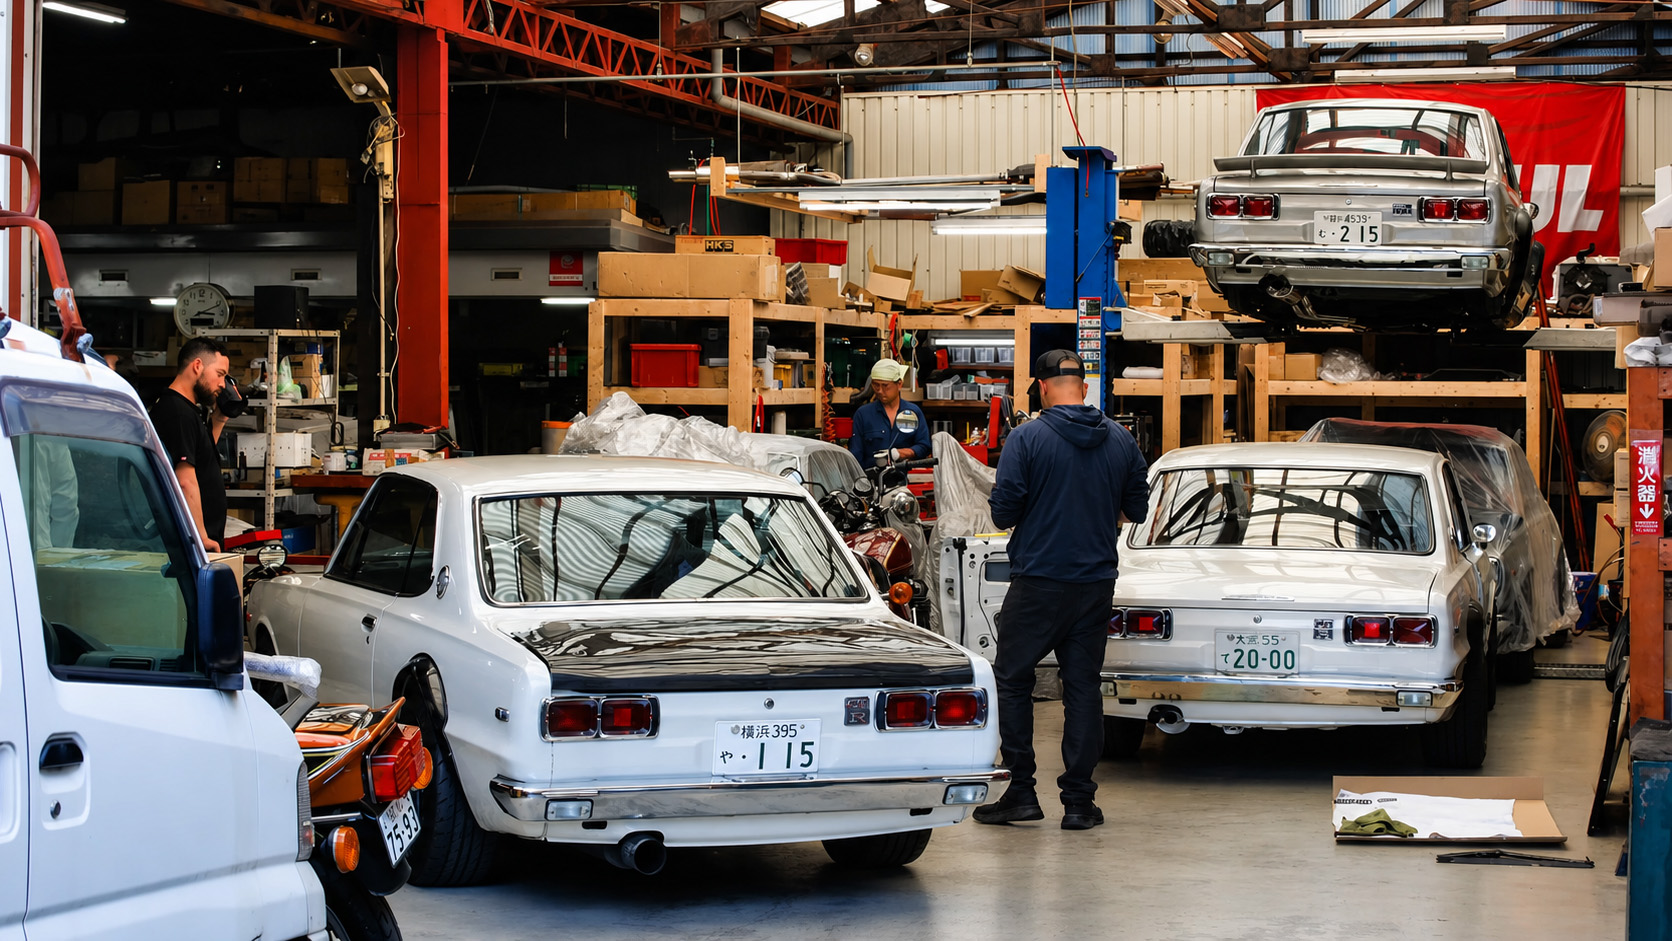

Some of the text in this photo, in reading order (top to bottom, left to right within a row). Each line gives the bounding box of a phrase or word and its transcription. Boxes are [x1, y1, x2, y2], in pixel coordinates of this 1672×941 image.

[705, 240, 734, 252] HKS
[1637, 445, 1657, 503] 消火器
[1262, 635, 1279, 646] 55
[1221, 648, 1295, 670] て 20-00
[740, 723, 797, 740] 横浜 395
[719, 750, 733, 764] や
